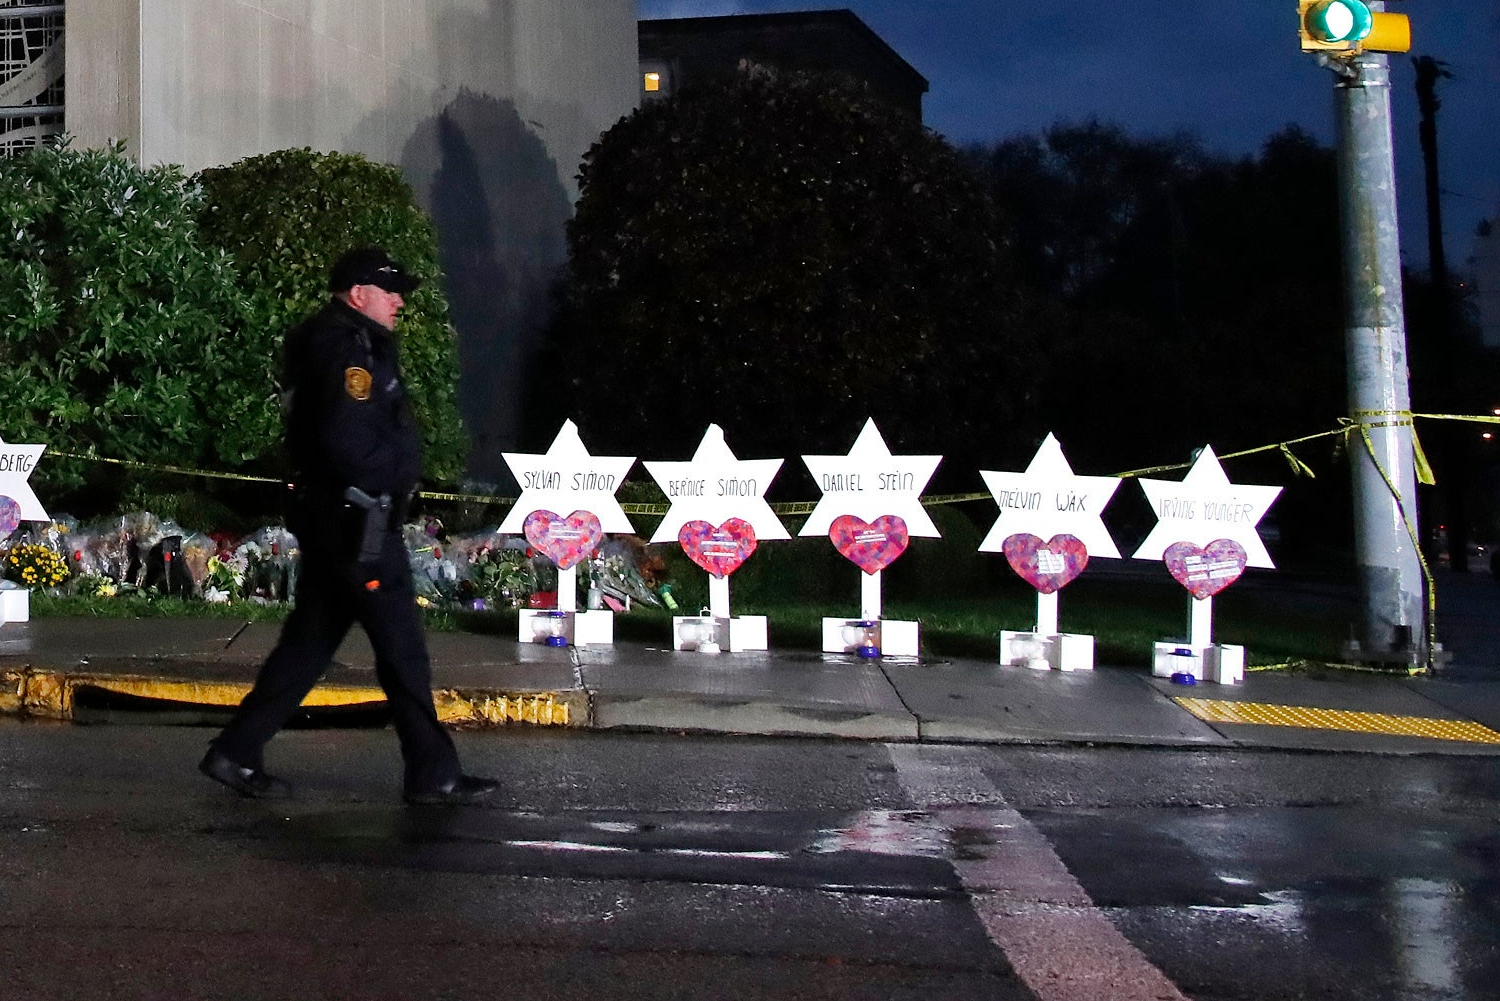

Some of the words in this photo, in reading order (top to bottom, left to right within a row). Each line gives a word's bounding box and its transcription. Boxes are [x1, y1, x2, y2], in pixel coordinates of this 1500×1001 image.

[523, 470, 561, 490] SYLVAN
[570, 472, 615, 491] SIMON
[669, 479, 706, 497] BERNICE
[717, 478, 757, 497] SIMON
[822, 473, 864, 492] DANIEL
[878, 472, 914, 491] STEIN
[999, 490, 1042, 511] MELVIN
[1055, 492, 1088, 512] WAX
[1159, 498, 1197, 520] IRVING
[1203, 501, 1254, 523] YOUNGER
